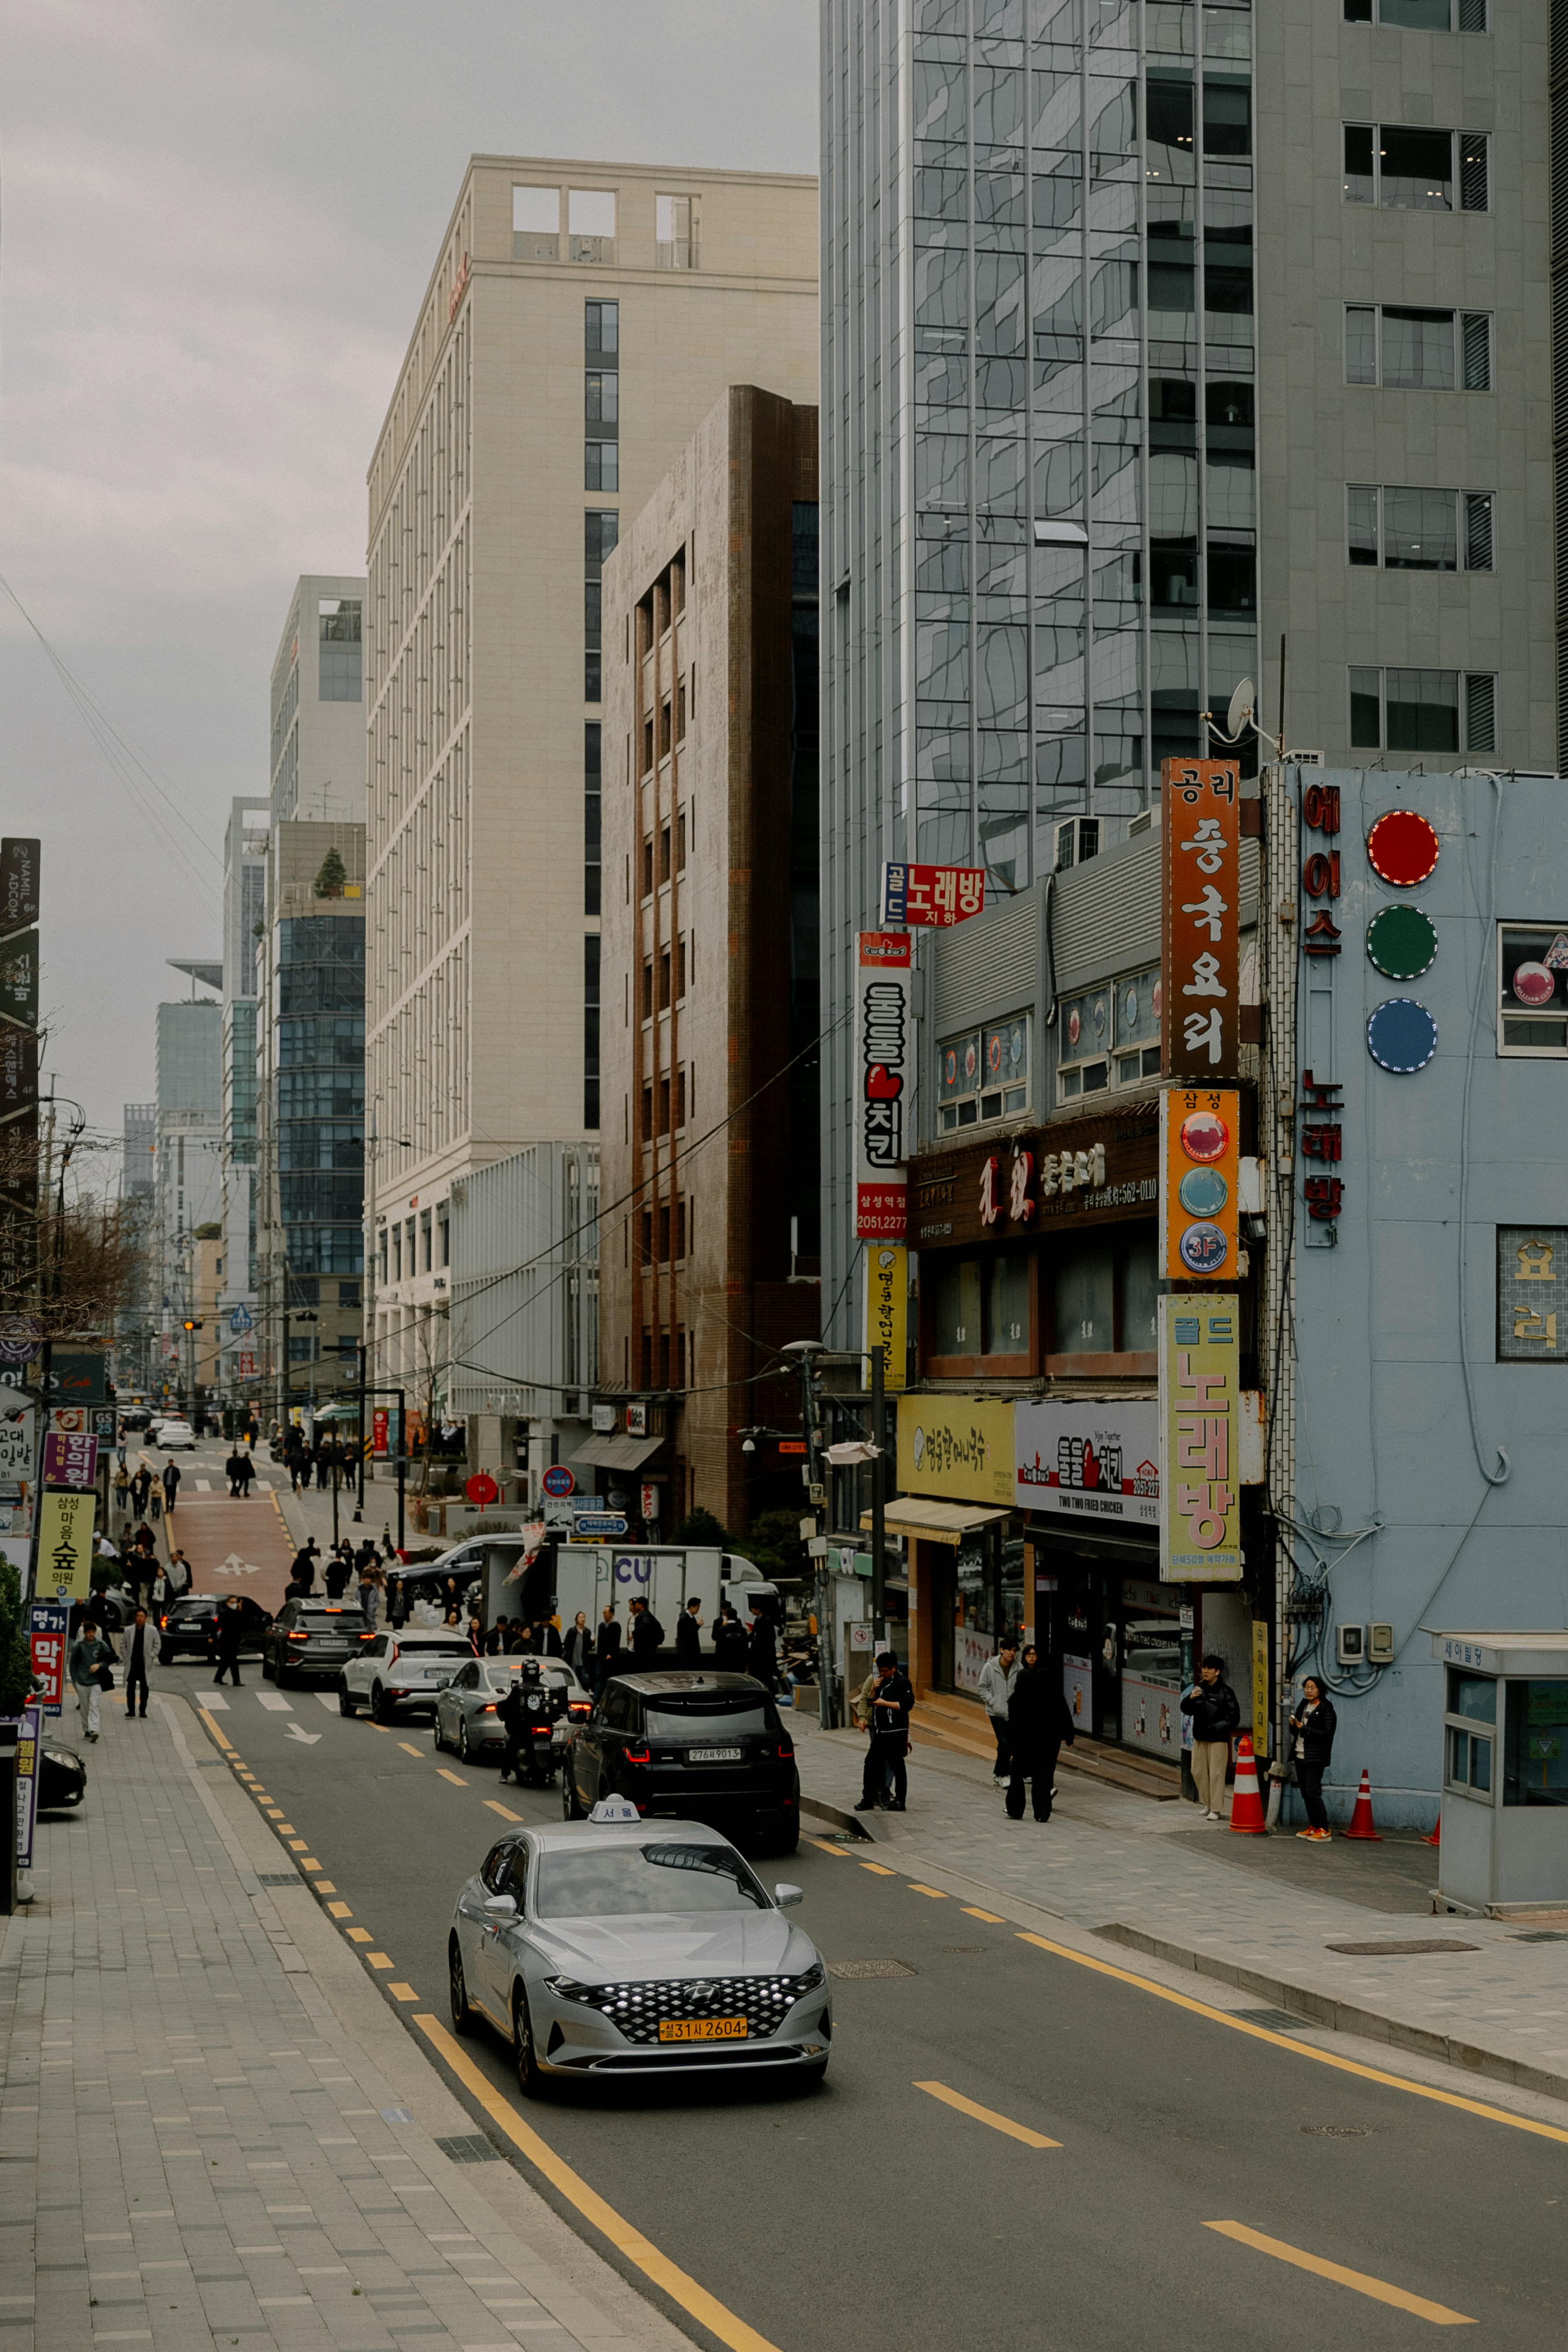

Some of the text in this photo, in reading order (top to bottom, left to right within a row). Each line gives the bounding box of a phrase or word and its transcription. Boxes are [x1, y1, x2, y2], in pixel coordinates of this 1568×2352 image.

[1173, 769, 1234, 805] 공리
[8, 860, 31, 919] NAMIL ADCOM
[886, 865, 983, 921] 골드 노래방
[925, 910, 958, 926] 지하
[1180, 818, 1228, 1064] 중국요리
[1300, 784, 1345, 1219] 에이스 노래방
[1516, 985, 1539, 1002] BILLIARD
[864, 982, 906, 1169] 둘둘 치킨
[22, 1085, 34, 1094] 4F
[1183, 1093, 1221, 1110] 삼성
[860, 1195, 906, 1209] 삼성역점
[1188, 1236, 1217, 1257] 3F
[1174, 1317, 1233, 1344] 골드
[95, 1412, 112, 1423] GS
[96, 1423, 112, 1434] 25
[925, 1425, 985, 1473] 명동할머니국수
[1175, 1352, 1234, 1549] 노래방
[64, 1436, 95, 1485] 한의원
[1058, 1436, 1084, 1487] 둘둘
[1098, 1445, 1123, 1491] 치킨
[57, 1497, 79, 1510] 삼성
[1059, 1495, 1123, 1515] TWO TWO FRIED CHICKEN
[1172, 1554, 1236, 1565] 단체50명 예약가능
[51, 1573, 73, 1585] 의원
[614, 1558, 651, 1584] CU
[33, 1610, 66, 1630] 명가
[1445, 1641, 1482, 1666] 세아빌딩
[35, 1640, 62, 1697] 막회
[603, 1807, 632, 1818] 서울
[705, 2020, 742, 2036] 2604
